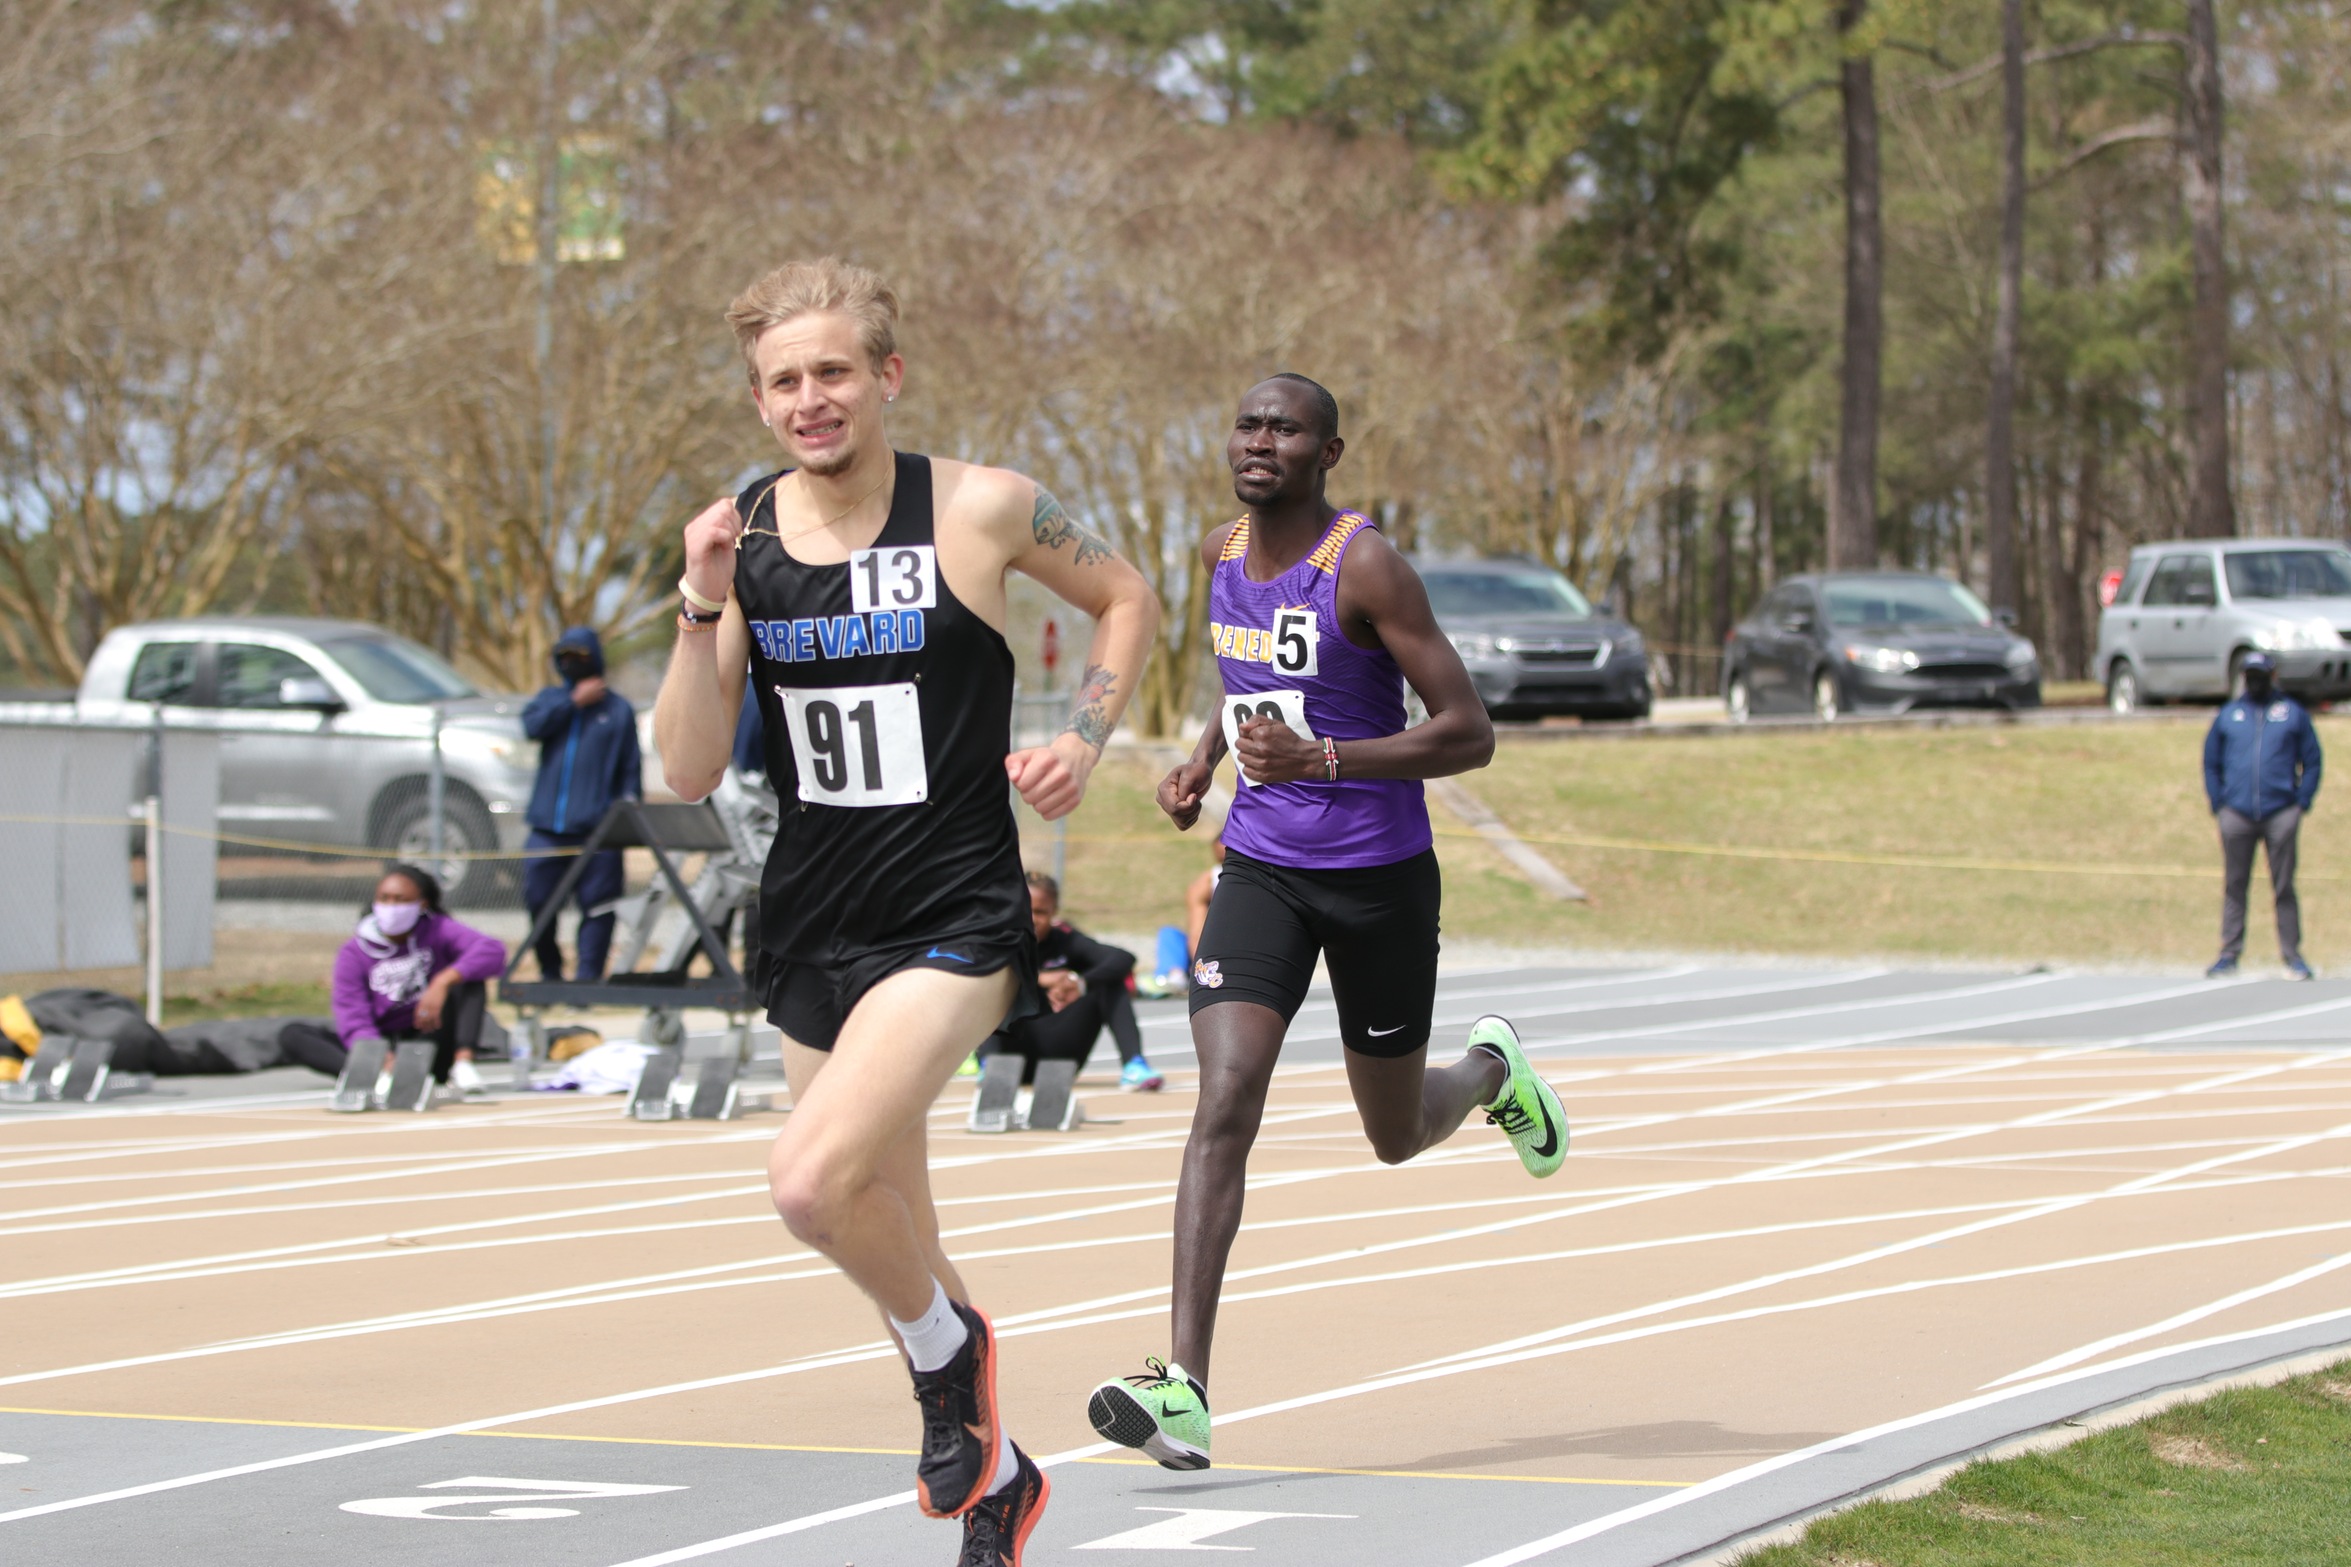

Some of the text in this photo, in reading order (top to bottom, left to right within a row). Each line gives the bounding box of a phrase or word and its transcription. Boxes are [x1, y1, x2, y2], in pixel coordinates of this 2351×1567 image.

[858, 550, 923, 607] 13
[749, 608, 925, 662] BREVARD
[1276, 614, 1308, 671] 5
[804, 699, 883, 793] 91
